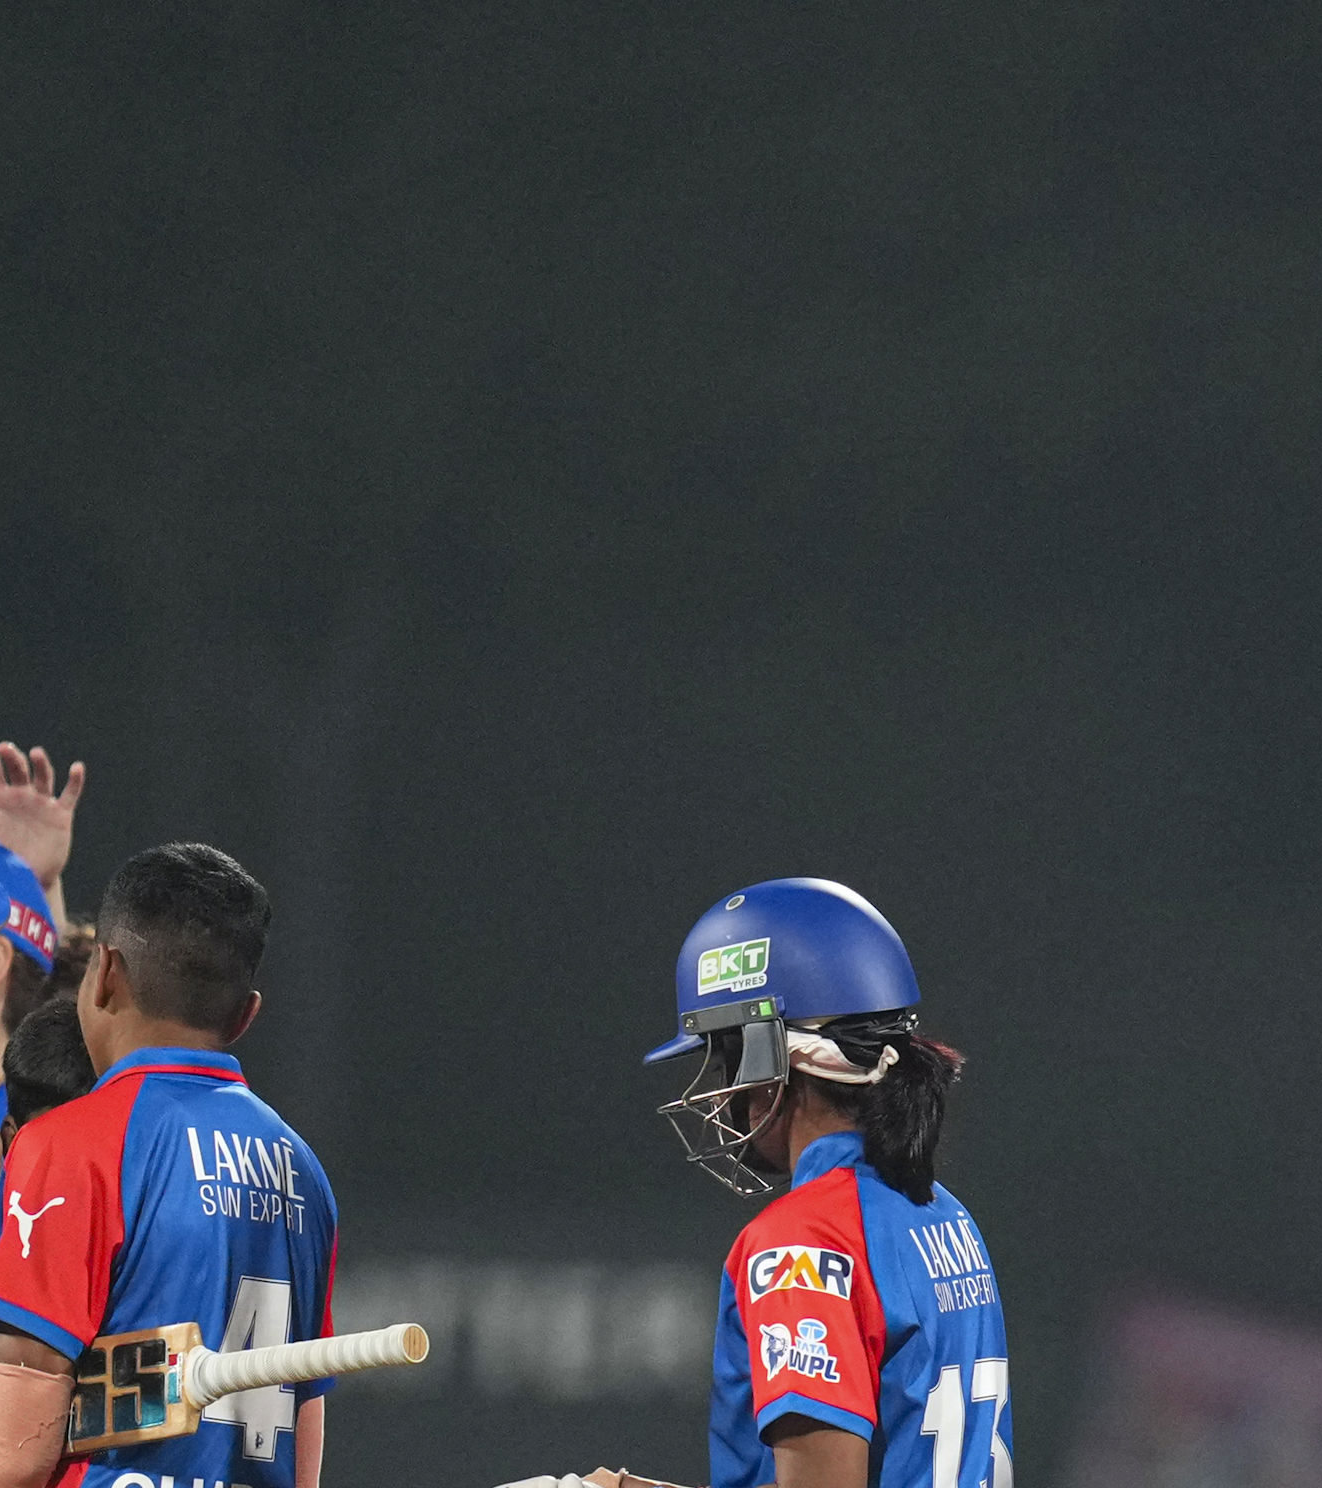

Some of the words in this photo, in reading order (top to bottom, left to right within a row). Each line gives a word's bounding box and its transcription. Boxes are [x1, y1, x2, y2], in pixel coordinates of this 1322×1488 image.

[701, 947, 765, 980] BKT
[732, 975, 765, 990] TYRES
[200, 1184, 241, 1218] SUN
[249, 1191, 305, 1234] EXPRT
[750, 1250, 851, 1297] GMR
[934, 1282, 955, 1313] SUN
[952, 1274, 995, 1310] EXPERT
[789, 1349, 838, 1381] WPL
[796, 1339, 826, 1356] TATA
[202, 1275, 296, 1462] 4
